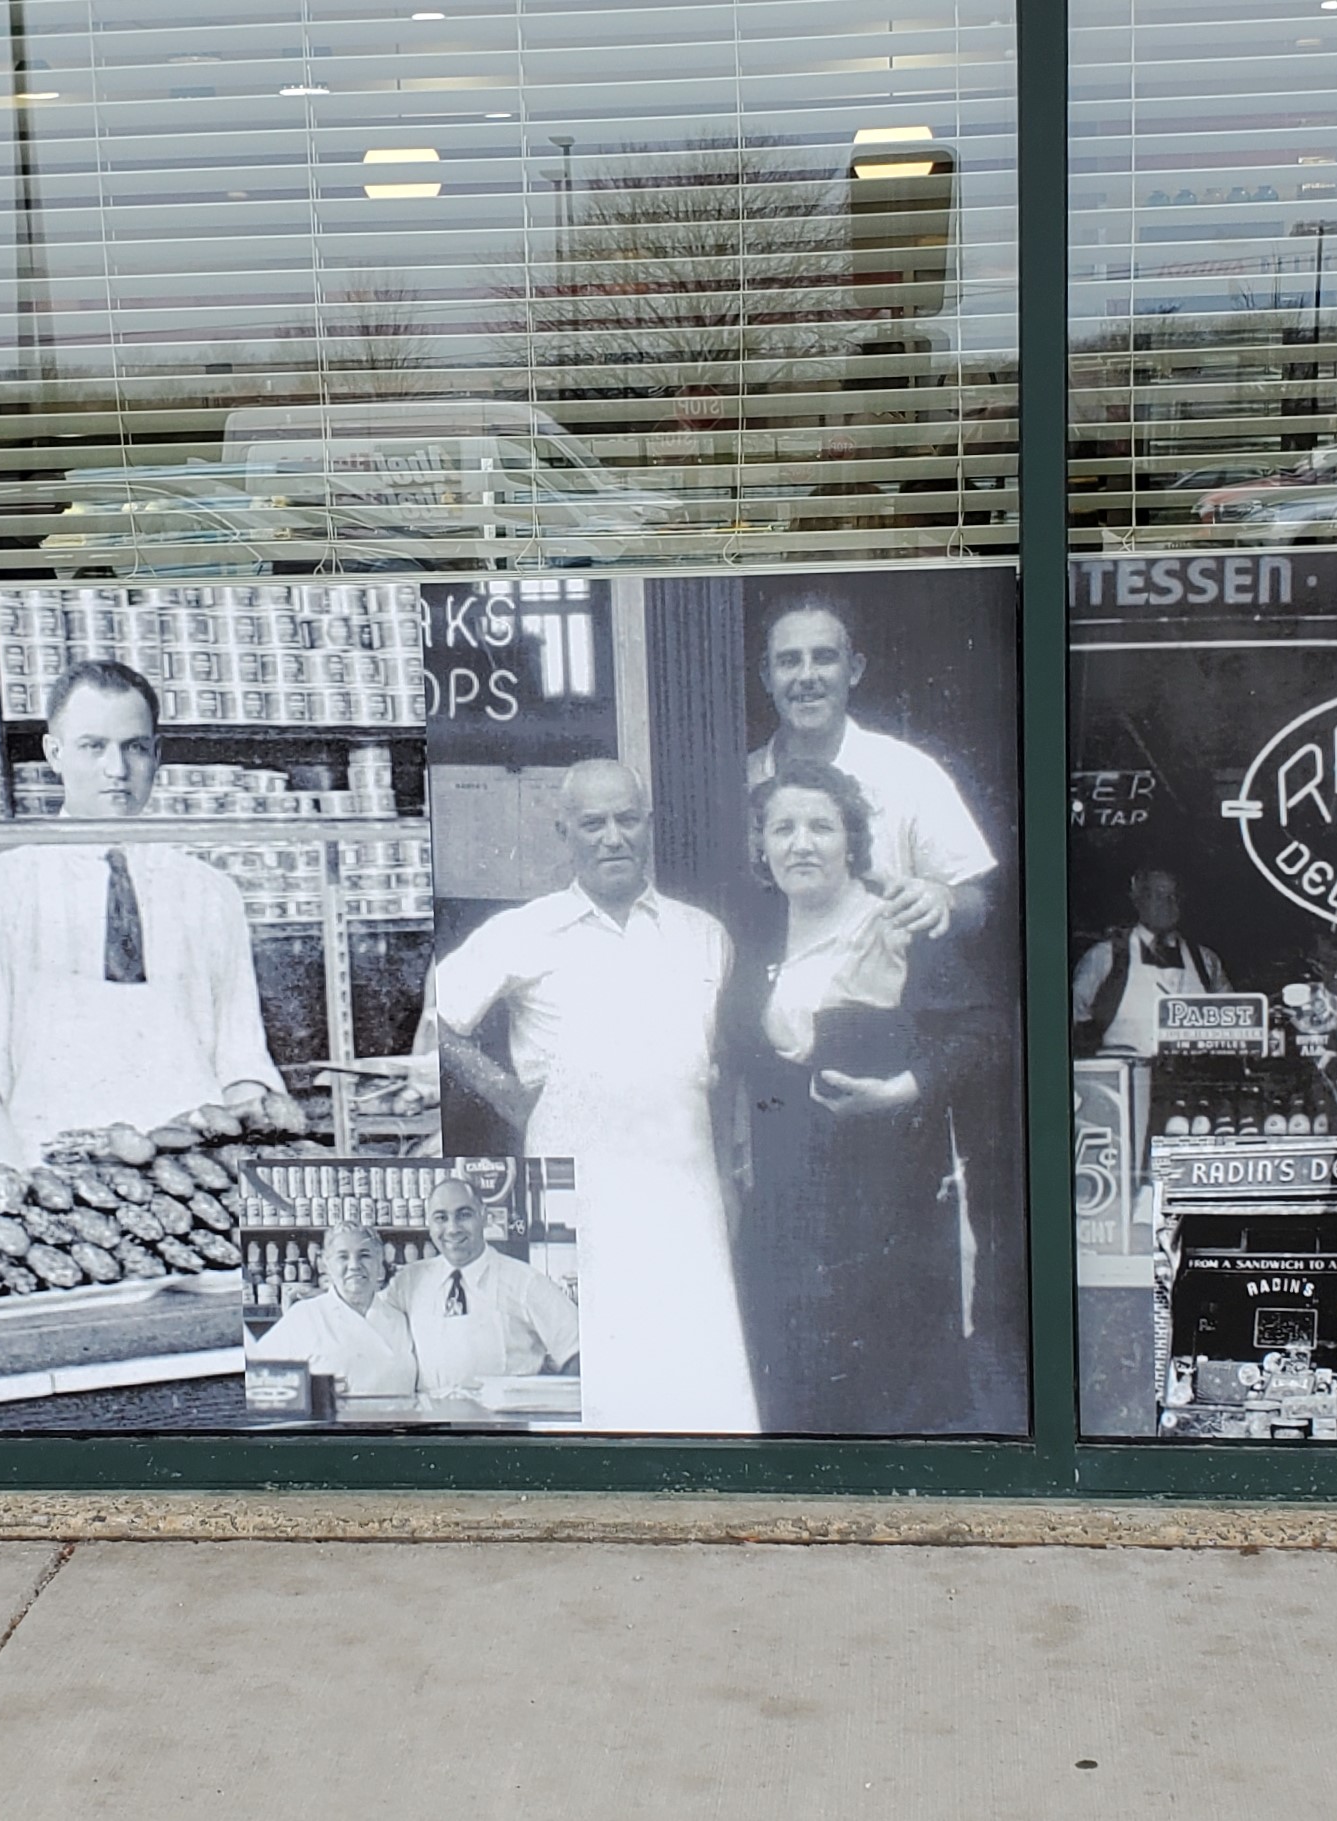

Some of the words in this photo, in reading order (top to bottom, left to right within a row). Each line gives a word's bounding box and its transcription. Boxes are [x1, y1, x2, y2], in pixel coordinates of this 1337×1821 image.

[1069, 556, 1293, 607] TESSEN
[1094, 808, 1149, 826] TAP
[1167, 1001, 1255, 1027] PABST
[1191, 1158, 1296, 1185] RADIN'S
[1222, 1260, 1232, 1269] A
[1236, 1260, 1304, 1270] SANDWICH
[1307, 1260, 1324, 1270] TO
[1247, 1277, 1316, 1298] RADIN'S
